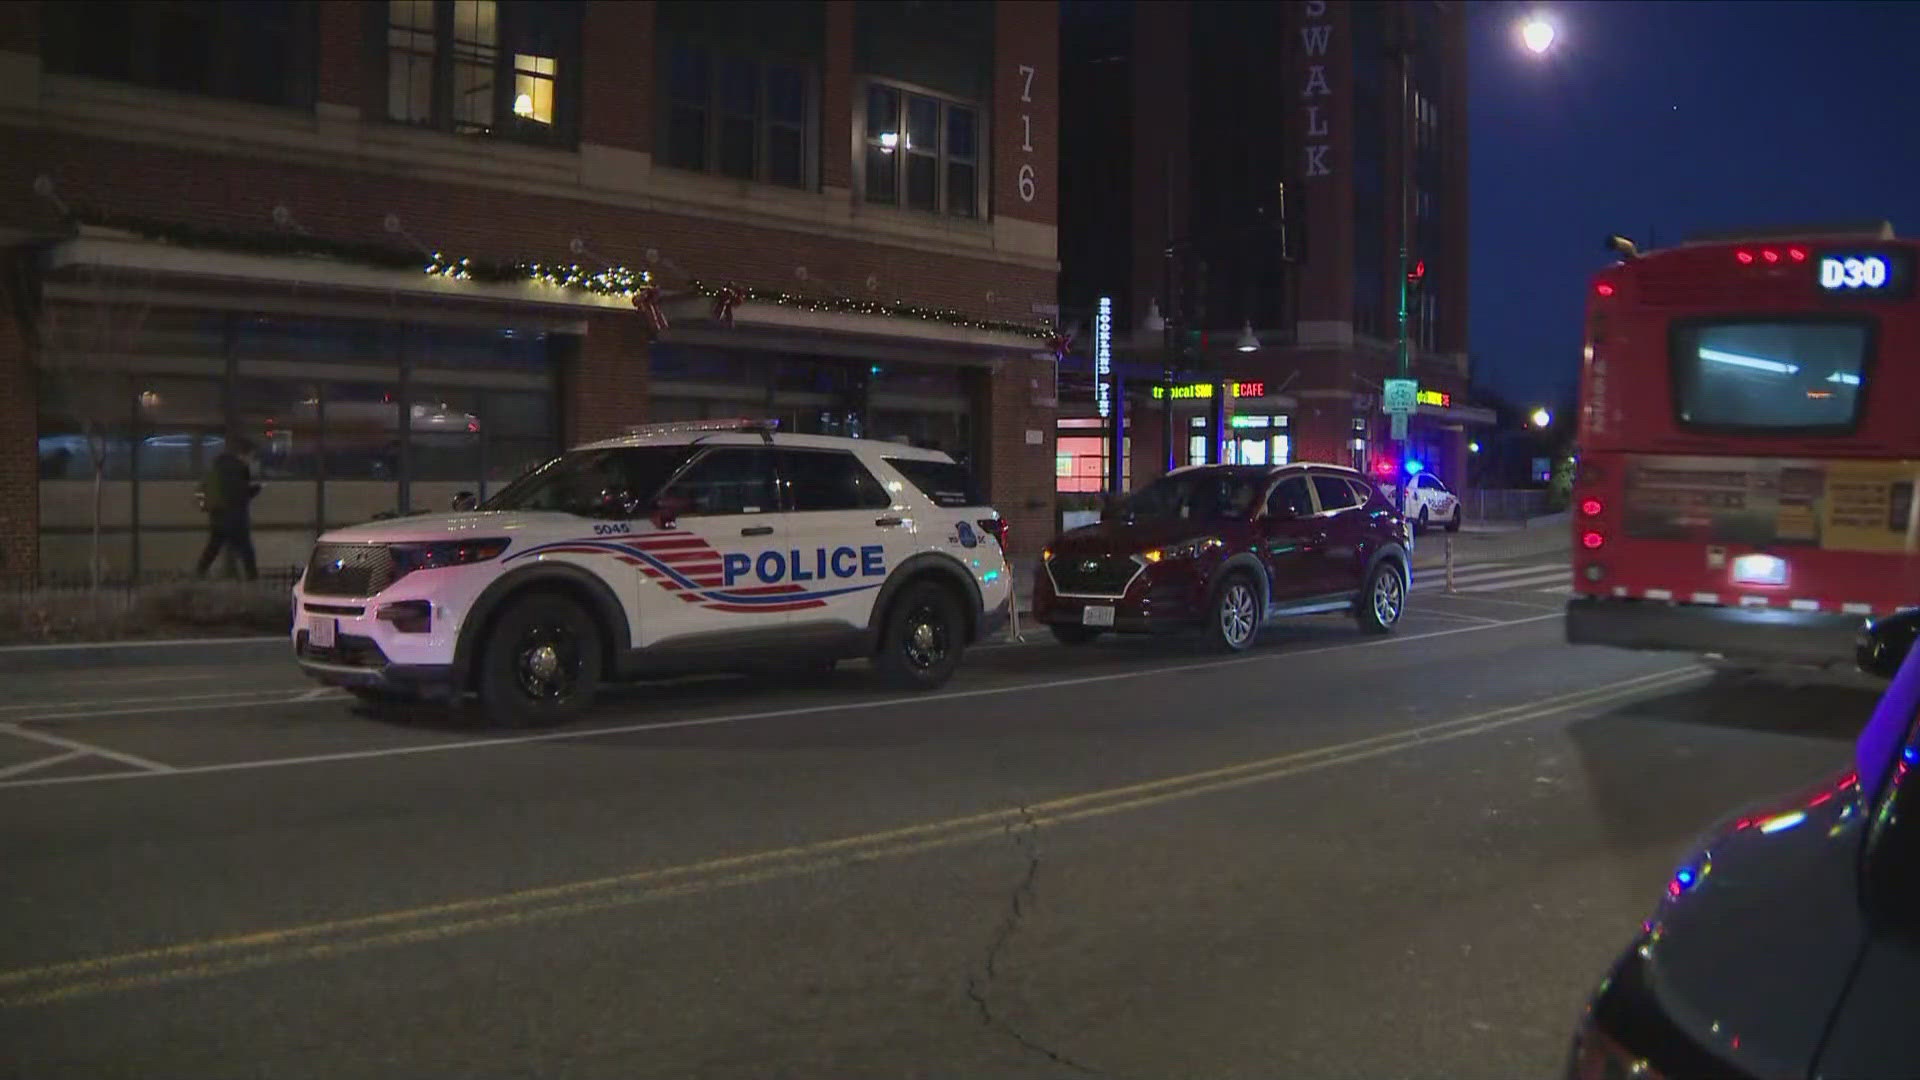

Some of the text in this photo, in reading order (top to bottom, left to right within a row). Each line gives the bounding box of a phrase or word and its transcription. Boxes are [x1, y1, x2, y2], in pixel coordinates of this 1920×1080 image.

[1018, 64, 1036, 203] 716
[1821, 256, 1886, 289] D30
[1153, 385, 1194, 399] trpical
[1240, 382, 1264, 397] CAFE
[593, 523, 630, 535] 5045
[723, 545, 886, 586] POLICE
